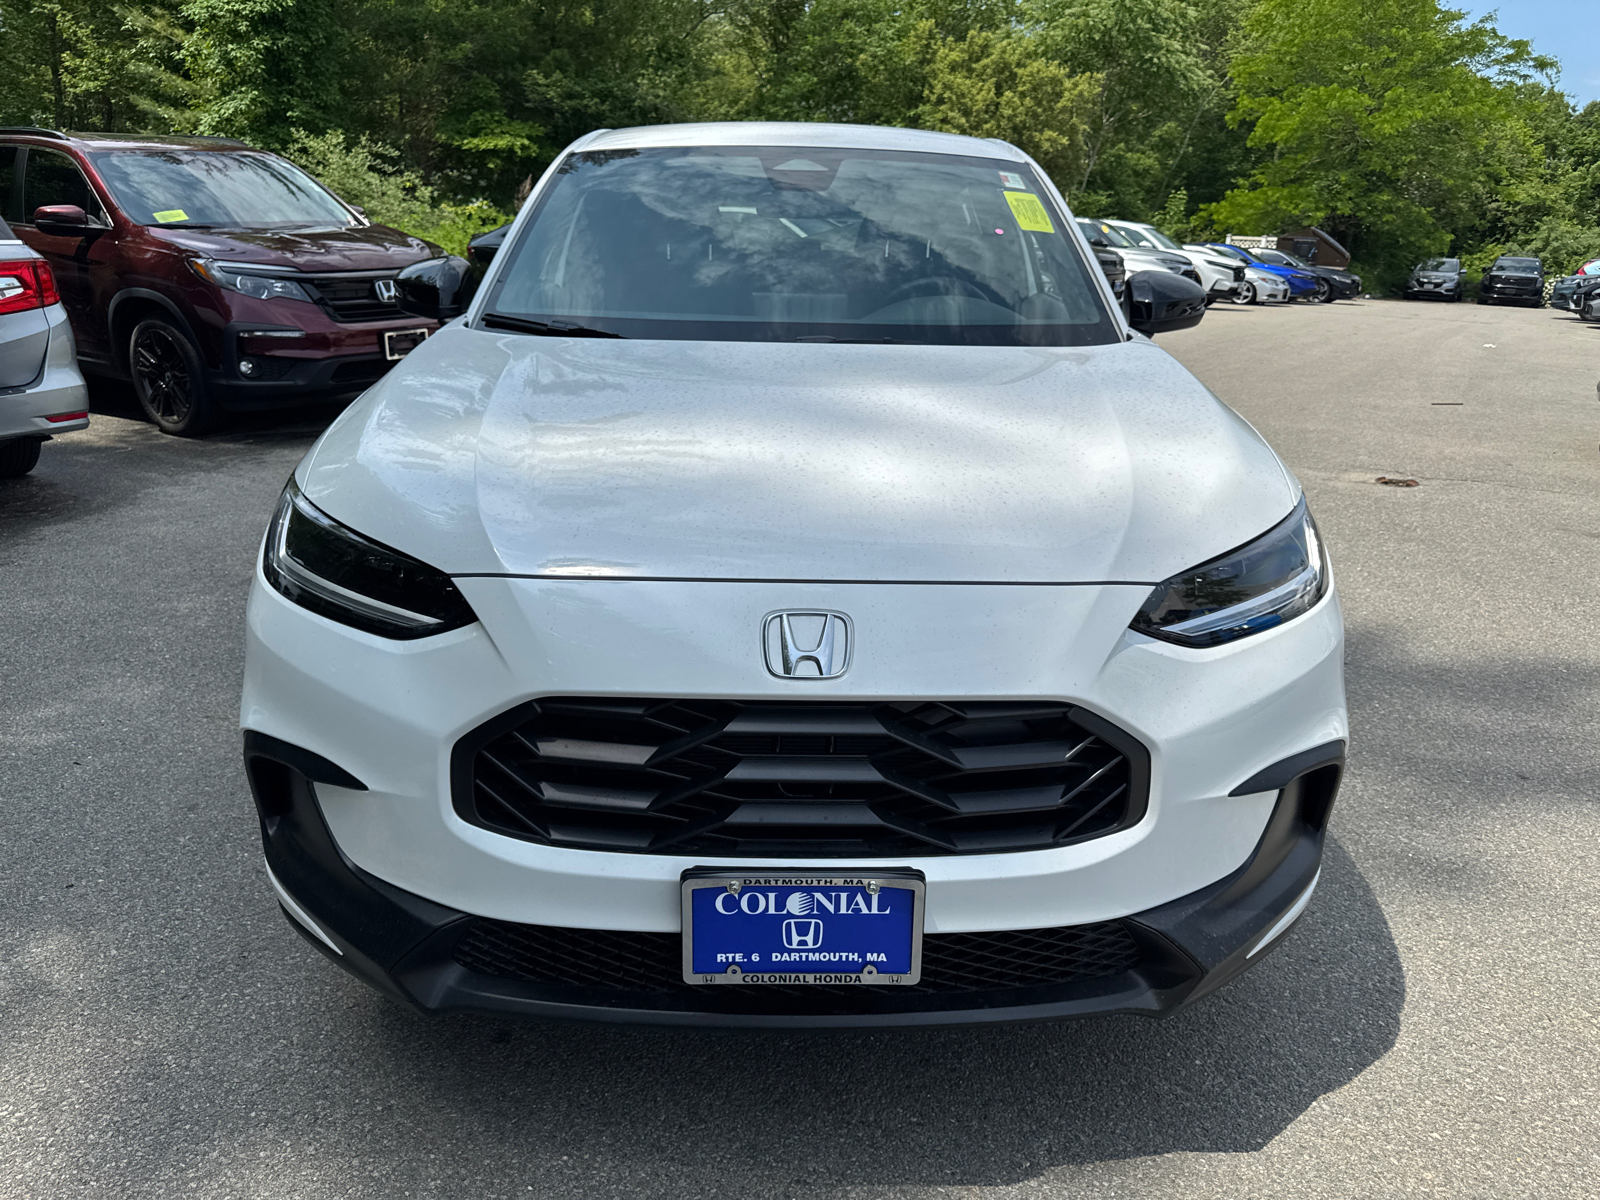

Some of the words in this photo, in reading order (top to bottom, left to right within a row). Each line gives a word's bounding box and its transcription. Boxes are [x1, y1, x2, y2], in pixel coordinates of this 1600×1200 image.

[743, 878, 838, 886] DARTMOUTH,
[843, 878, 864, 886] MA
[715, 891, 891, 916] COLONIAL
[717, 953, 748, 963] RTE.
[751, 952, 760, 962] 6
[771, 952, 863, 963] DARTMOUTH,
[866, 952, 887, 962] MA
[742, 974, 810, 984] COLONIAL
[813, 974, 862, 984] HONDA
